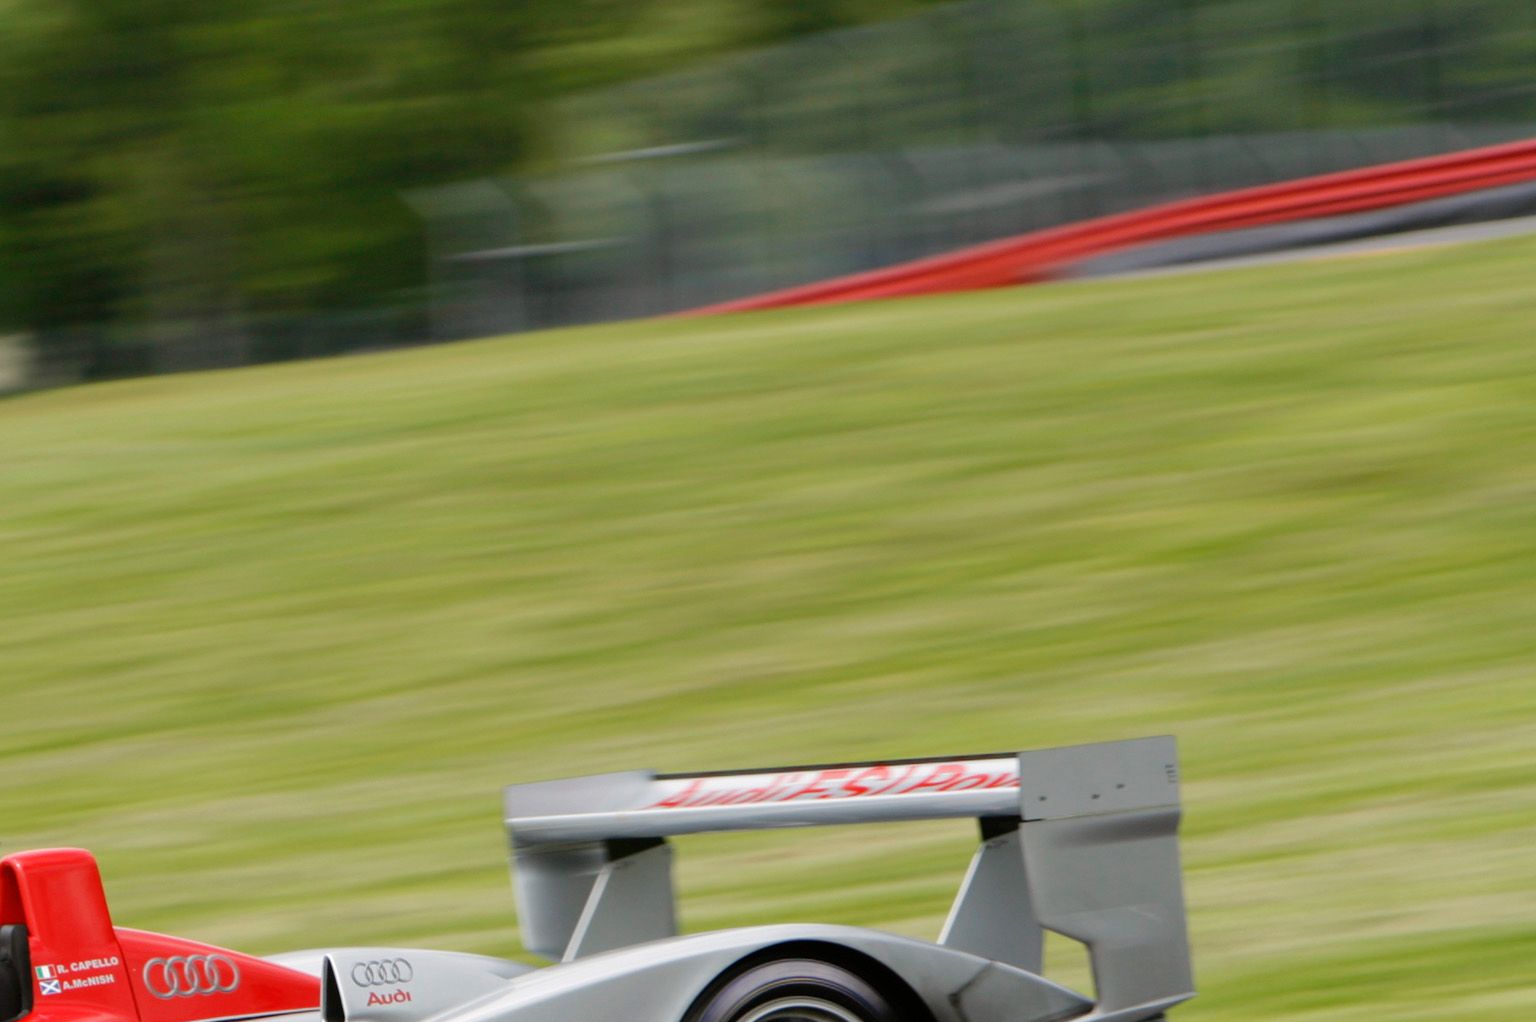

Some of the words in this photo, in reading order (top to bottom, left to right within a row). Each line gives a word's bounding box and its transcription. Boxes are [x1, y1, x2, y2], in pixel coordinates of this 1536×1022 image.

[56, 964, 69, 974] R.
[70, 956, 119, 972] CAPELLO
[367, 989, 412, 1006] Audi
